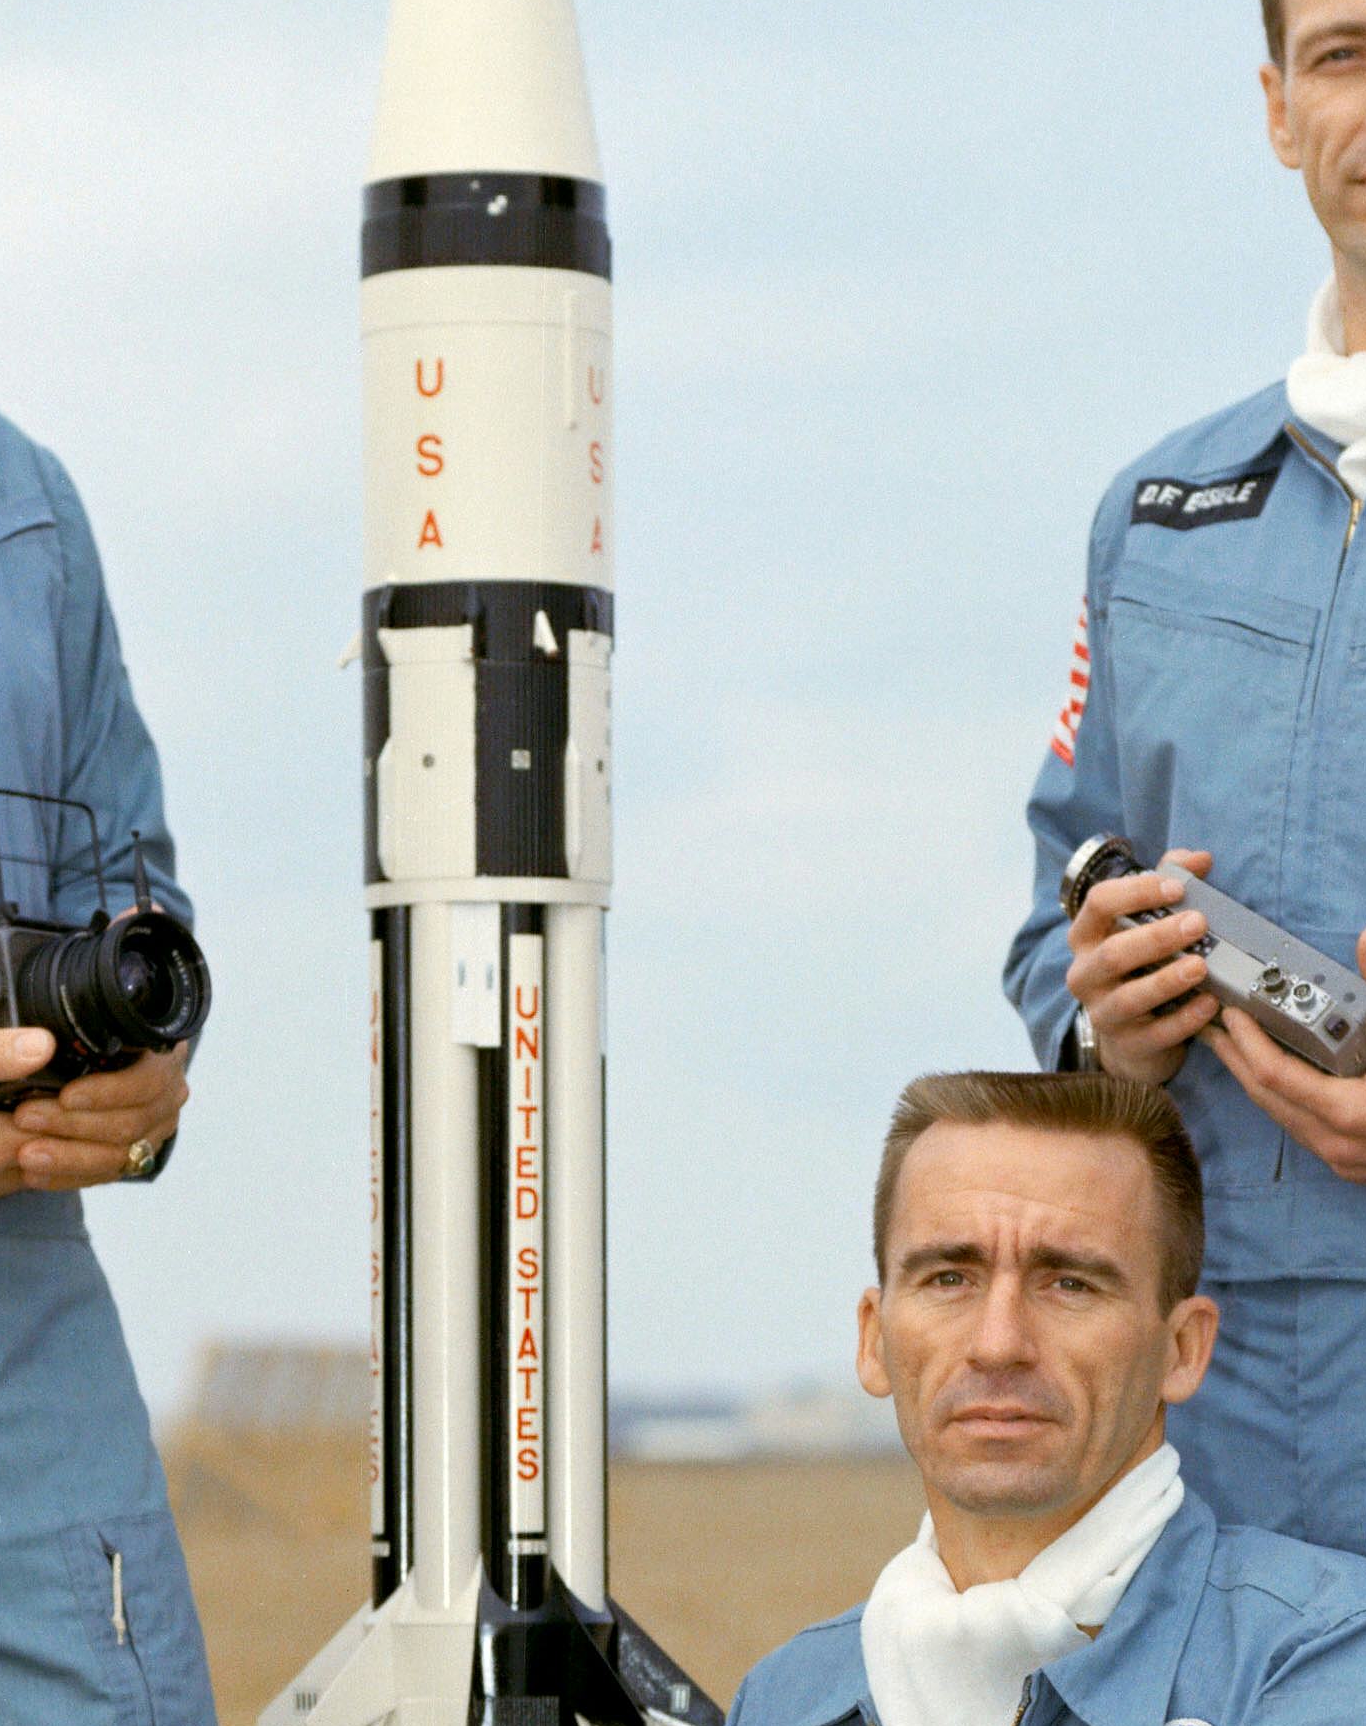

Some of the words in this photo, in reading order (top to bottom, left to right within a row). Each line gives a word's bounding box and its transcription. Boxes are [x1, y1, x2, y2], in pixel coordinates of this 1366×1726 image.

[415, 357, 444, 550] USA
[588, 365, 604, 553] USA
[515, 984, 539, 1220] UNITED
[516, 1247, 540, 1482] STATES
